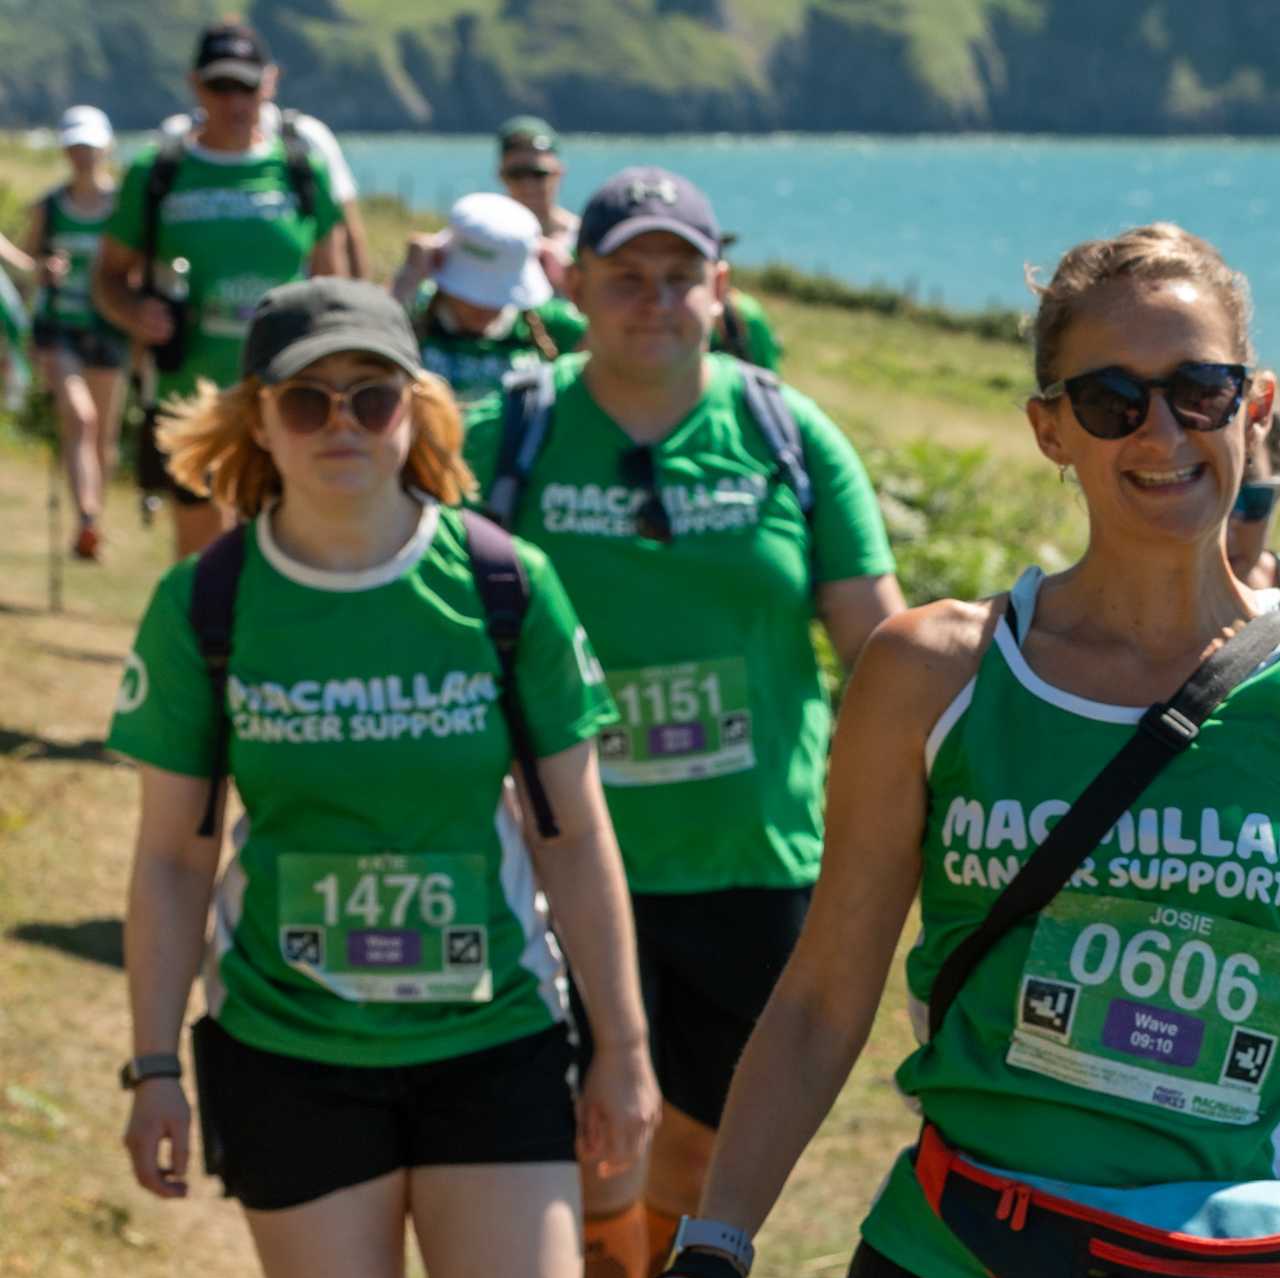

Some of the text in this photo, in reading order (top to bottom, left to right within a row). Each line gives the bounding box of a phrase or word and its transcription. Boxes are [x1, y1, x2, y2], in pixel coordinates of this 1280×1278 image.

[620, 674, 721, 726] 1151
[350, 704, 488, 741] SUPPORT
[944, 851, 1099, 890] CANR
[313, 873, 456, 927] 1476
[1149, 906, 1215, 936] JOSIE
[1069, 923, 1261, 1023] 0606
[1130, 1031, 1173, 1054] 09:10
[1135, 1012, 1178, 1036] Wave
